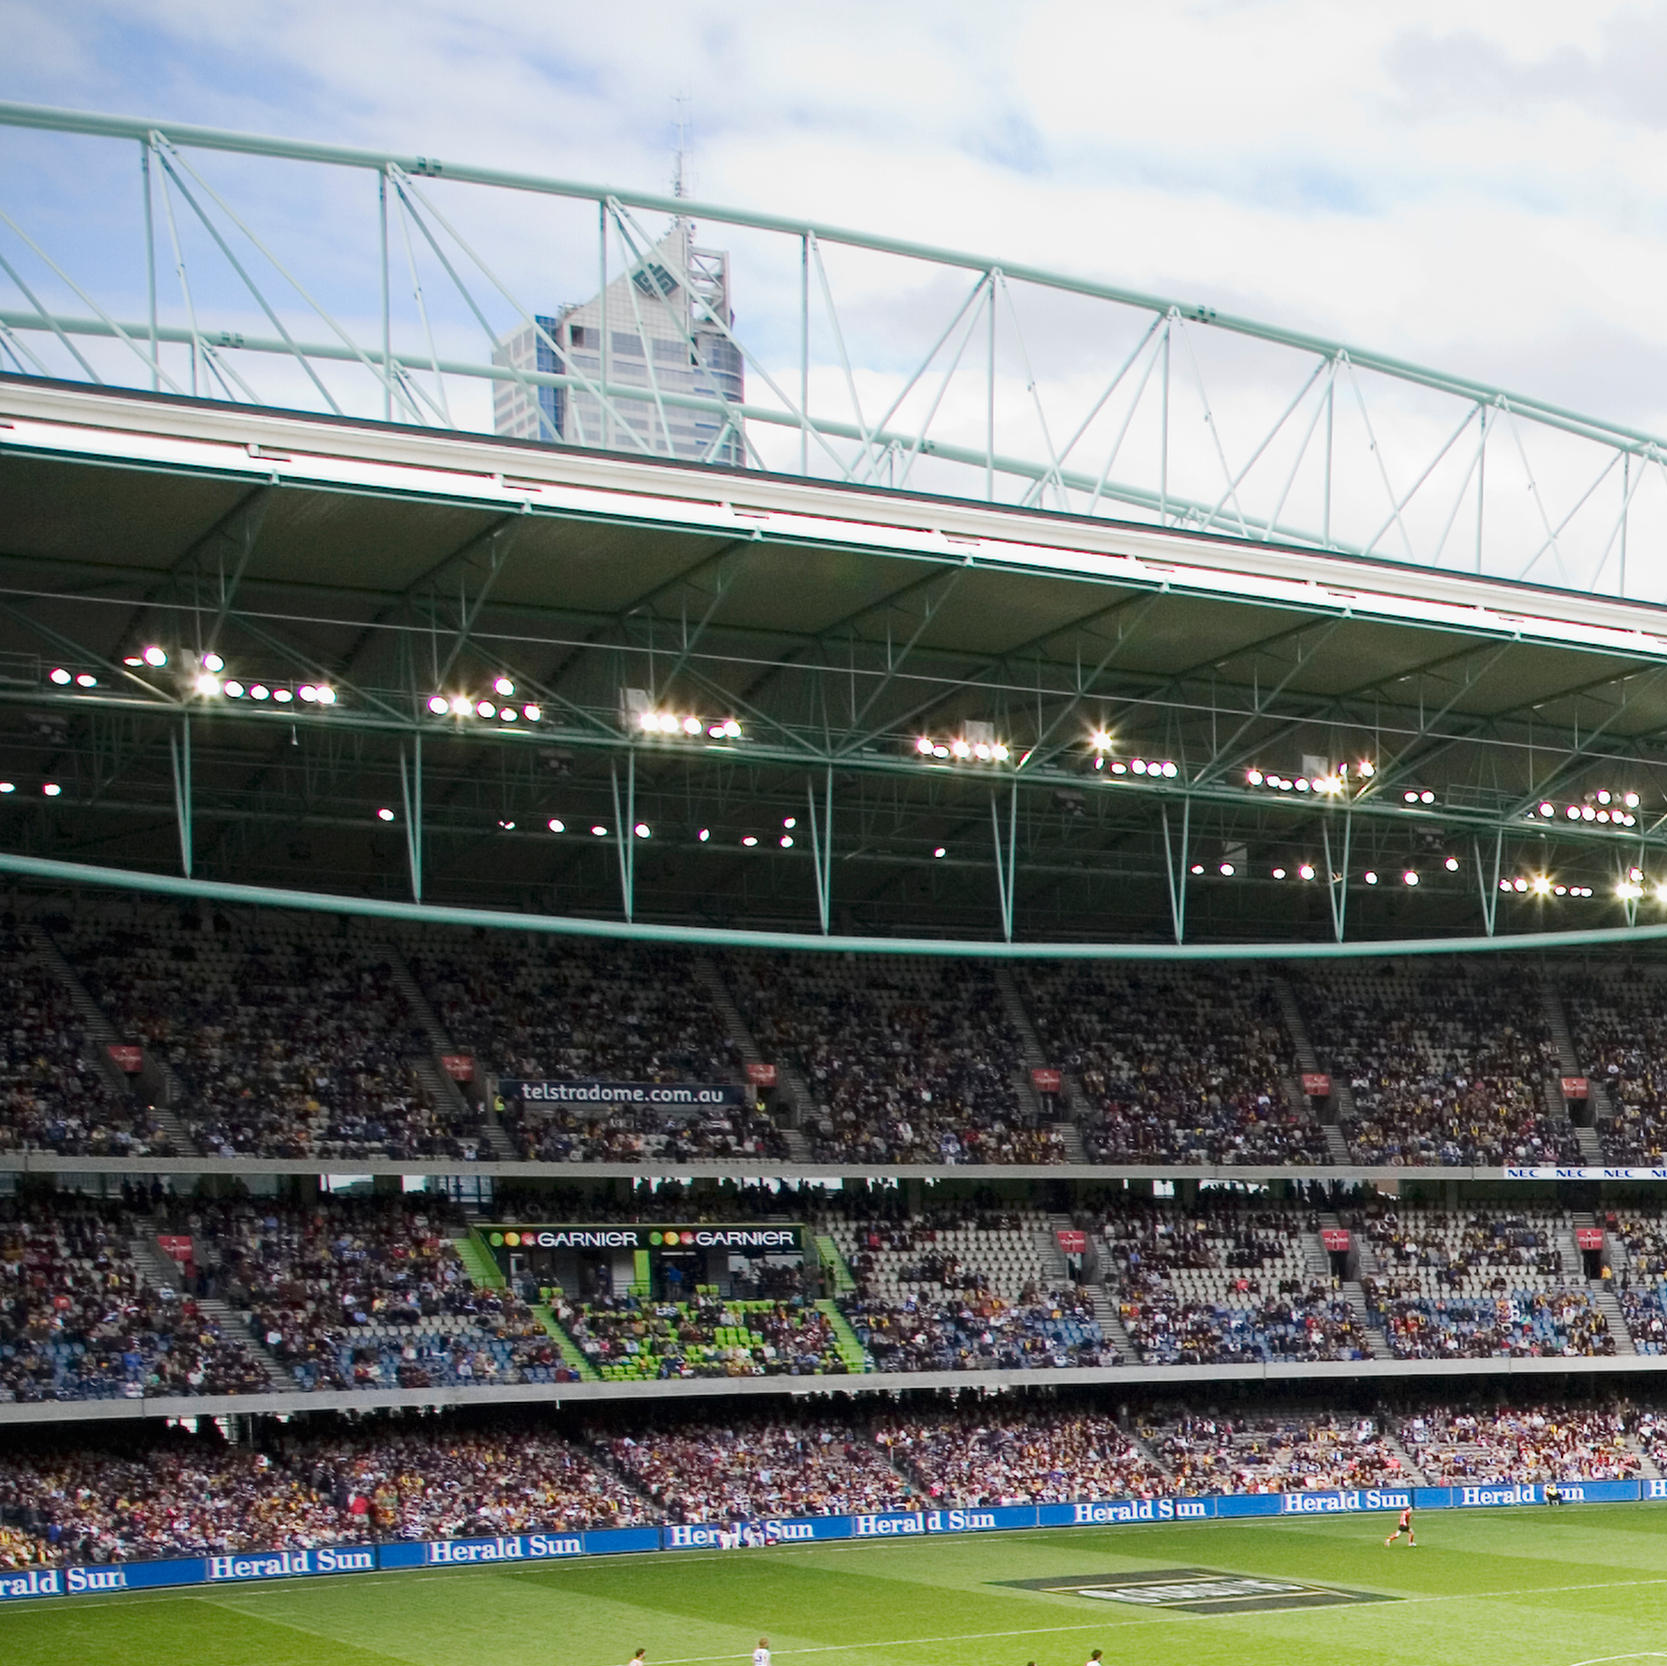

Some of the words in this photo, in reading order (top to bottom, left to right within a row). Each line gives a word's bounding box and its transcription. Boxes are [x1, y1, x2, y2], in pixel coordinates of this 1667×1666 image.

[521, 1083, 723, 1103] telstradome.com.au
[1507, 1168, 1541, 1179] NEC
[537, 1232, 638, 1247] GARNIER
[696, 1231, 794, 1246] GARNIER
[1284, 1492, 1362, 1512] Herald
[1364, 1490, 1411, 1510] Sun
[1462, 1485, 1536, 1506] Herald
[1544, 1482, 1586, 1502] un
[1074, 1500, 1155, 1523] Herald
[1159, 1498, 1207, 1518] Sun
[671, 1521, 760, 1547] Herl
[764, 1520, 815, 1540] Sun
[856, 1511, 943, 1538] Herald
[949, 1510, 997, 1530] Sun
[429, 1537, 523, 1563] Herald
[529, 1535, 582, 1557] Sun
[208, 1549, 311, 1579] Herald
[317, 1548, 373, 1572] Sun
[67, 1567, 128, 1592] Sun
